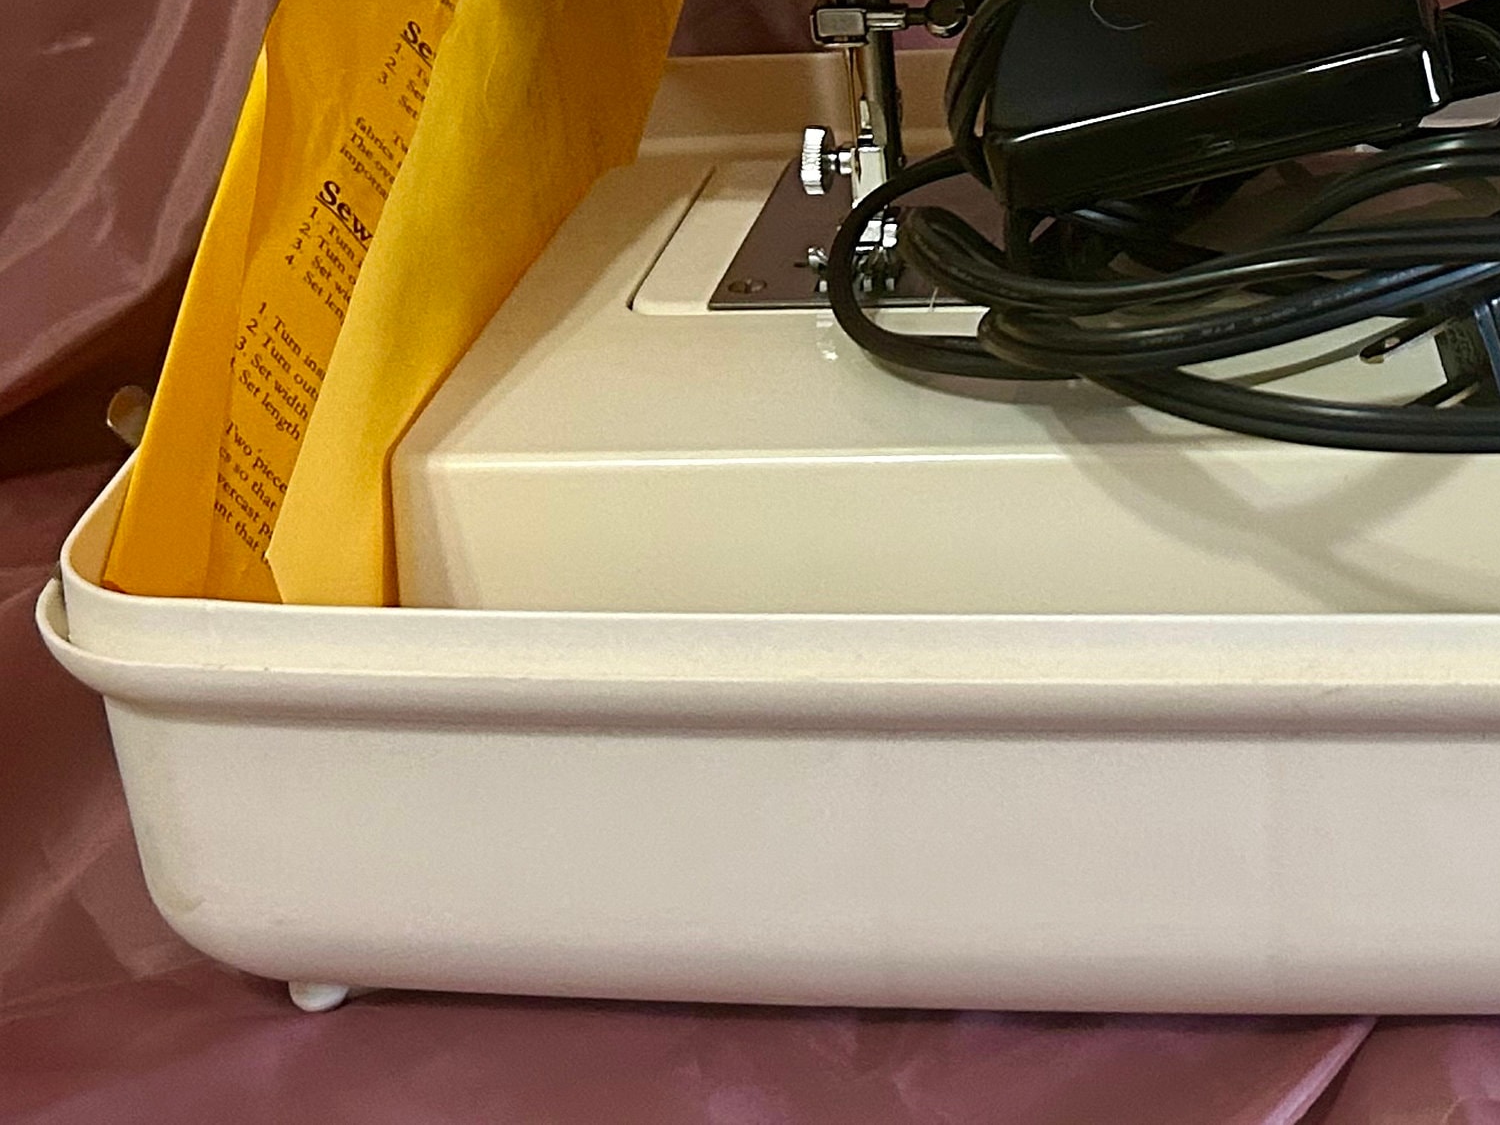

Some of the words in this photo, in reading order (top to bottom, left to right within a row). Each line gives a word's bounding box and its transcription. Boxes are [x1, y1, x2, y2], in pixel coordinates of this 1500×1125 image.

[403, 20, 437, 61] Se
[319, 180, 374, 242] Sew
[317, 234, 347, 274] Turn
[327, 221, 356, 261] Turn
[303, 270, 323, 297] Set
[311, 255, 333, 281] Set
[261, 331, 292, 375] Turn
[273, 315, 302, 357] Turn
[238, 368, 261, 399] Set
[261, 391, 301, 443] length
[250, 353, 273, 382] Set
[274, 379, 309, 423] width
[251, 480, 278, 514] that
[234, 520, 260, 554] that
